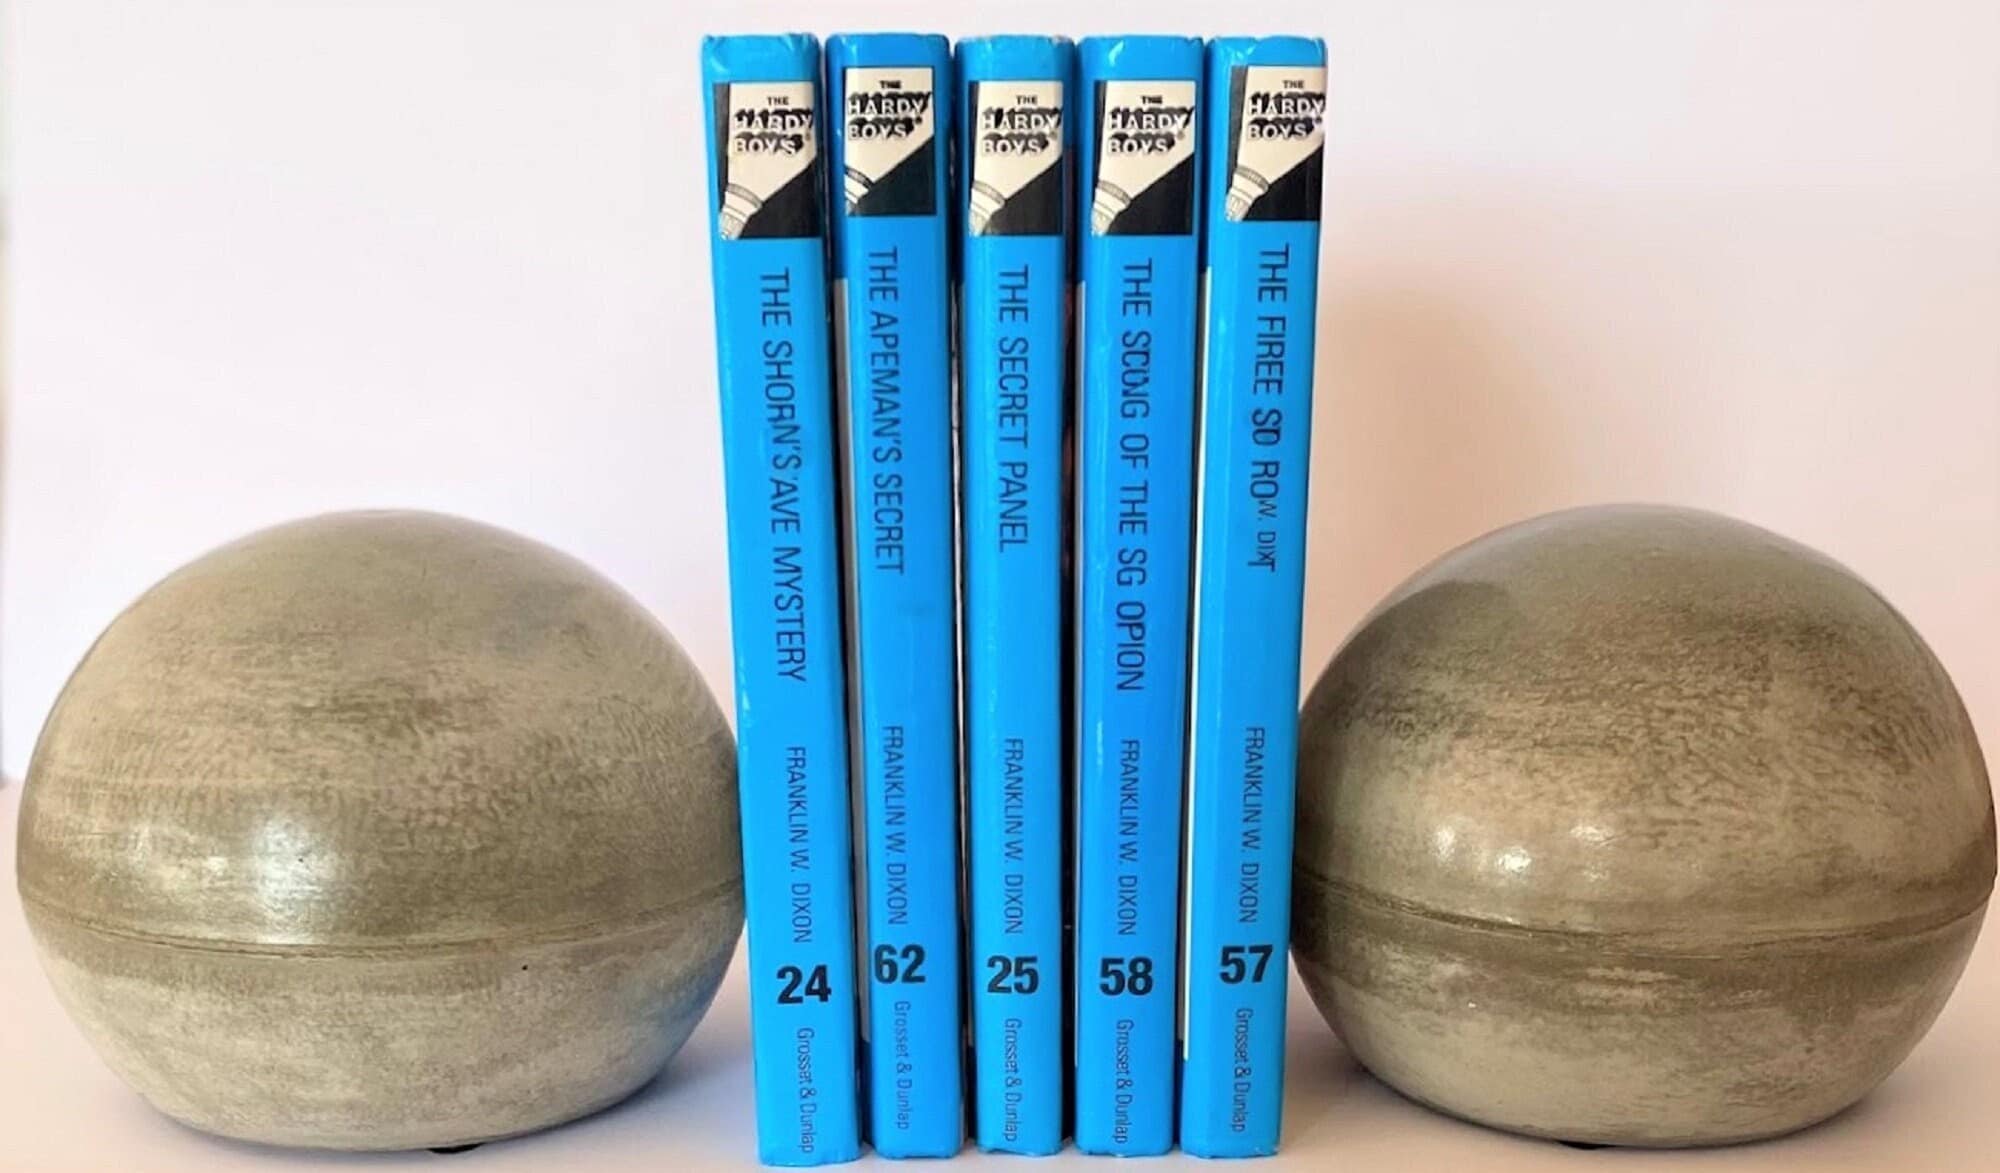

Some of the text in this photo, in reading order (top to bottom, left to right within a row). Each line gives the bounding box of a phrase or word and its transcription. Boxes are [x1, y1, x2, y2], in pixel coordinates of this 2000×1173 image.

[767, 96, 789, 105] THE
[848, 92, 932, 115] HARDY
[880, 80, 902, 89] THE
[1016, 95, 1038, 105] THE
[1141, 95, 1163, 105] THE
[1247, 92, 1326, 115] HARDY
[1282, 80, 1305, 89] THE
[734, 109, 814, 131] HARDY
[982, 107, 1063, 130] HARDY
[1107, 107, 1194, 130] HARDY
[760, 267, 792, 327] THE
[1122, 257, 1153, 317] THE
[1257, 243, 1290, 303] THE
[1253, 316, 1287, 395] FIREE
[869, 246, 904, 574] THE APEMAN'S SECRET
[998, 264, 1029, 553] THE SECRET PANEL
[1119, 433, 1150, 469] OF
[1118, 479, 1149, 535] THE
[1116, 547, 1147, 587] SG
[772, 546, 807, 682] MYSTERY
[1115, 601, 1146, 691] OPION
[787, 746, 808, 843] FRANKLIN
[884, 726, 906, 825] FRANKLIN
[1004, 738, 1024, 834] FRANKLIN
[1119, 739, 1140, 836] FRANKLIN
[1242, 727, 1266, 823] FRANKLIN
[791, 883, 812, 943] DIXON
[886, 863, 908, 924] DIXON
[1004, 874, 1023, 934] DIXON
[1117, 875, 1138, 936] DIXON
[1239, 863, 1260, 923] DIXON
[776, 964, 832, 1005] 24
[874, 943, 926, 984] 62
[987, 955, 1039, 995] 25
[1099, 956, 1154, 997] 58
[1219, 944, 1273, 985] 57
[797, 1027, 817, 1153] Grosset & Dunlap
[894, 1001, 913, 1130] Grosset & Dunlap
[1003, 1018, 1023, 1142] Grosset & Dunlap
[1114, 1019, 1134, 1144] Grosset & Dunlap
[1232, 1007, 1253, 1133] Grosset & Dunlap
